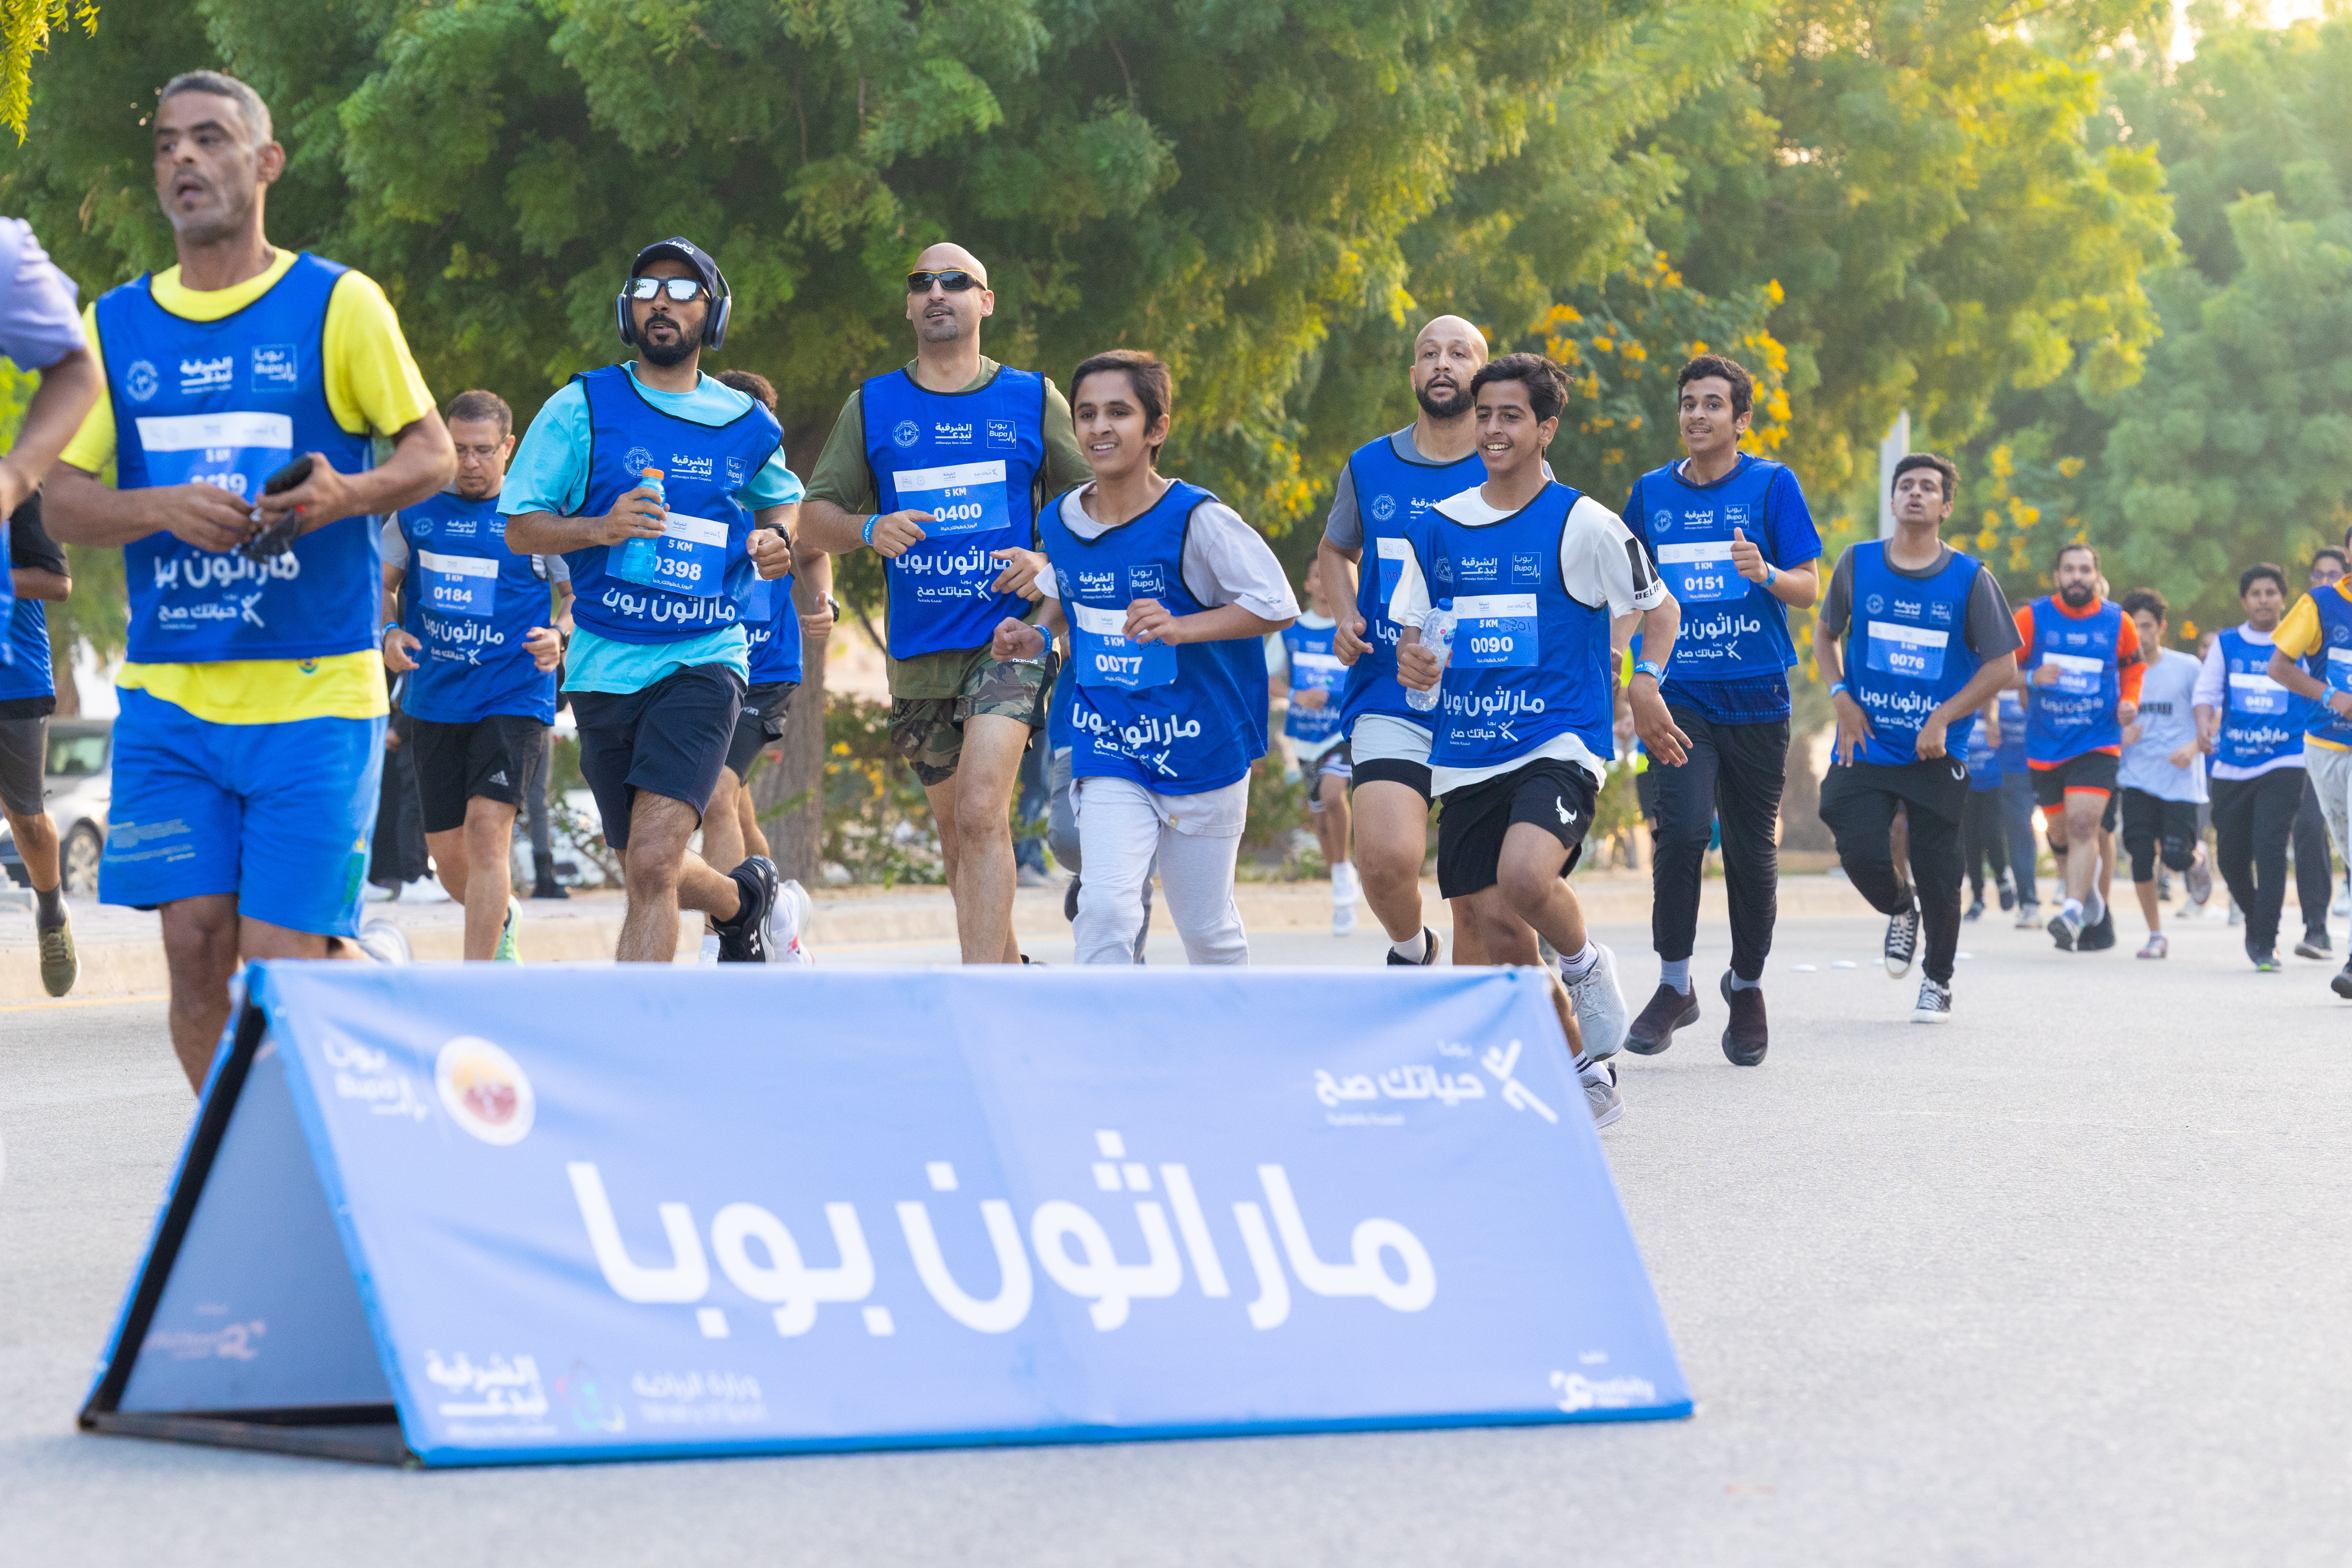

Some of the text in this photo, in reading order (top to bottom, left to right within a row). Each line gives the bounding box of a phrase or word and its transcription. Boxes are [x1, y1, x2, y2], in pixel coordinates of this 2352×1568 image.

[935, 422, 972, 433] الشرقية
[671, 453, 713, 467] الشرقية
[727, 469, 740, 479] Bupa
[945, 487, 967, 497] 5 KM
[1411, 497, 1443, 508] شرقية
[934, 503, 982, 523] 0400
[1684, 510, 1713, 520] الشرقية
[668, 539, 693, 552] 5 KM
[1461, 557, 1498, 568] الشرقية
[1694, 561, 1713, 570] 5 KM
[652, 578, 693, 590] #بوبا_خطواتك_حيا
[1079, 571, 1114, 585] الشرقية
[1131, 580, 1154, 589] Bupa
[1684, 576, 1724, 591] 0151
[434, 586, 472, 603] 0184
[917, 586, 972, 598] حياتك صح
[1479, 619, 1485, 628] 5
[1486, 619, 1498, 628] KM
[1692, 612, 1761, 640] ماراثون
[441, 619, 504, 645] ماراثون
[1103, 636, 1125, 647] 5 KM
[1470, 636, 1513, 654] 0090
[1677, 649, 1724, 659] حياتك صح
[1096, 654, 1143, 674] 0077
[1890, 652, 1925, 670] 0076
[1464, 685, 1545, 717] ماراثون
[1860, 686, 1888, 709] بوبا
[1451, 728, 1496, 740] حياتك صح
[1094, 737, 1118, 751] صح
[1313, 1064, 1487, 1108] حياتك صح
[565, 1128, 1437, 1339] ماراثون بوبا
